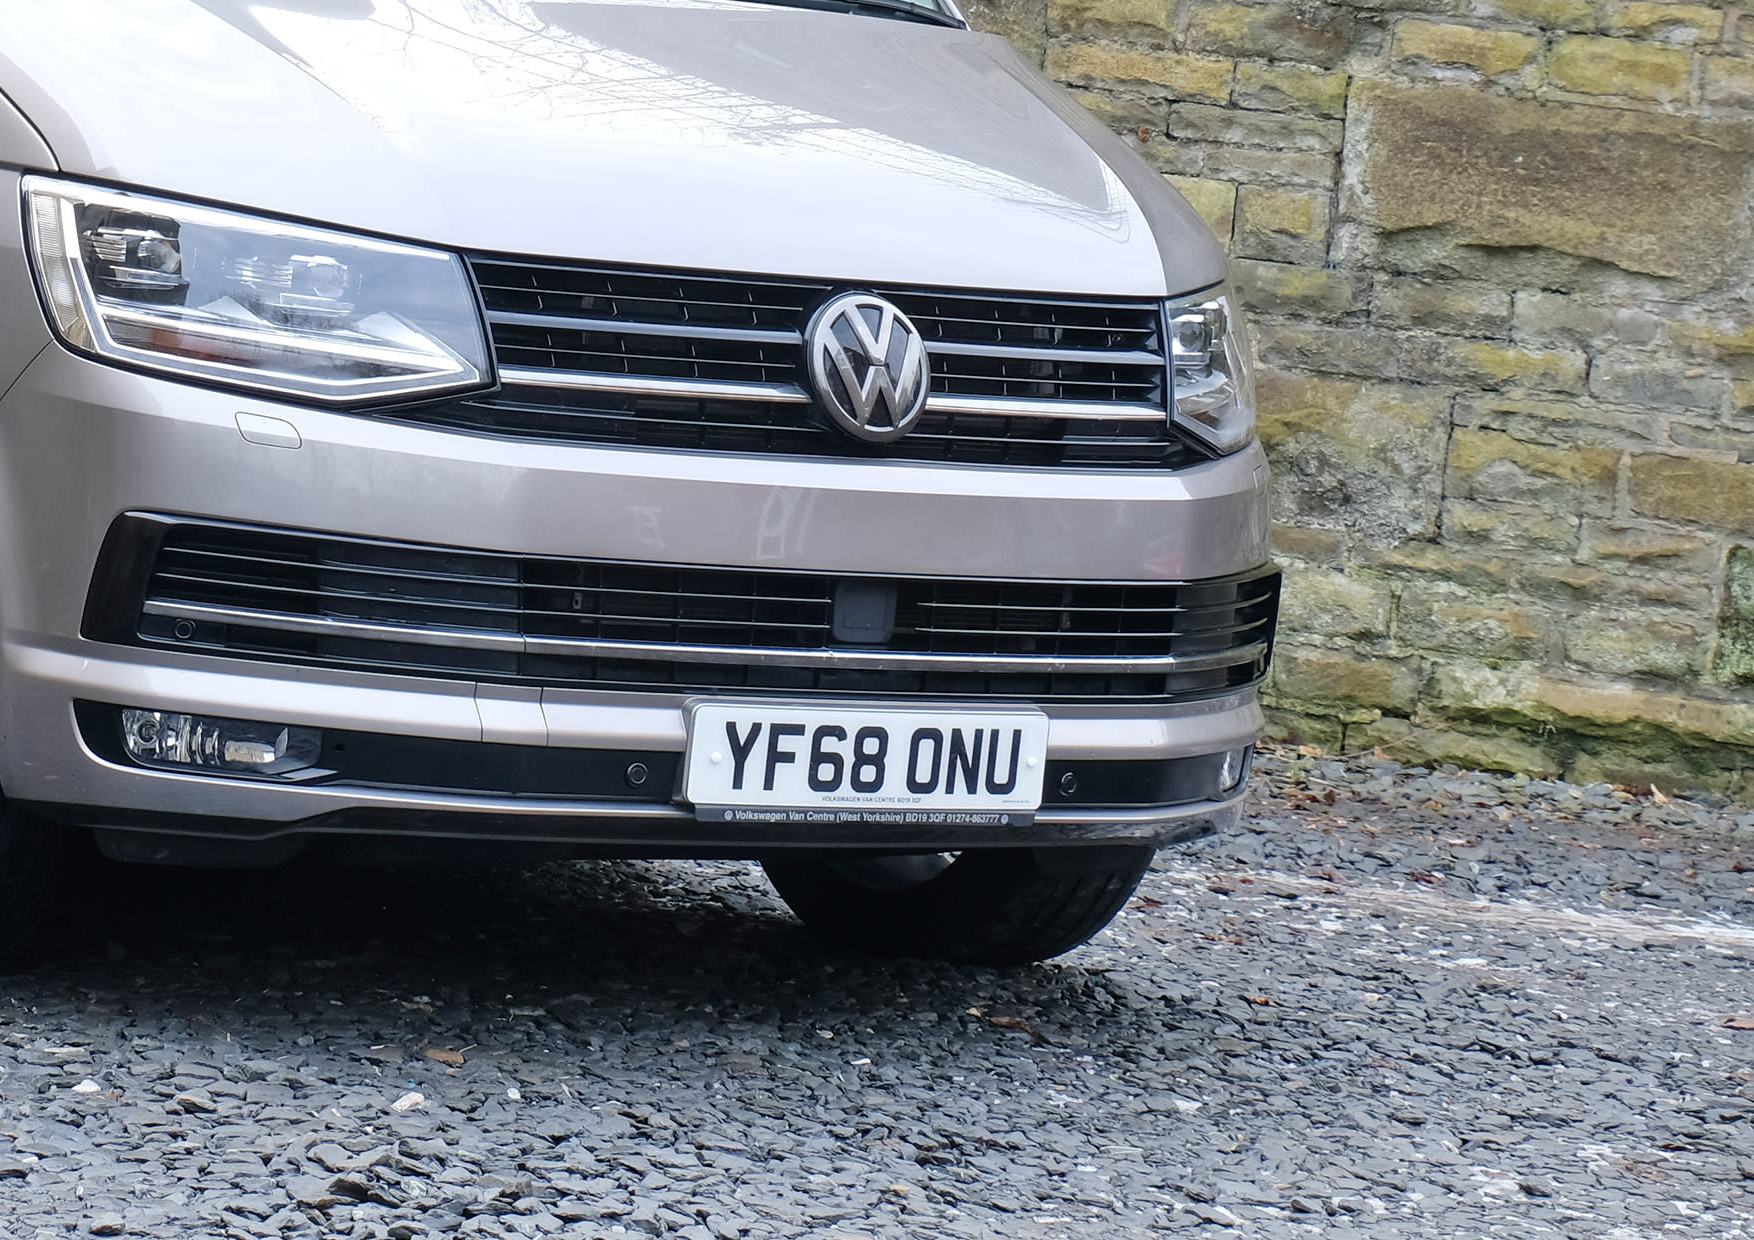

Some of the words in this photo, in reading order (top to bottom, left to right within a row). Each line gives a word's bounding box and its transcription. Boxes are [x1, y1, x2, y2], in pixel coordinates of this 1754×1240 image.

[724, 721, 890, 794] YF68
[905, 726, 1023, 795] ONU
[821, 795, 861, 803] VOLKSWAGEN
[735, 809, 787, 823] Volkswagen
[788, 810, 805, 821] Van
[806, 811, 835, 821] Centre
[836, 811, 861, 823] (West
[862, 811, 904, 824] Yorkshire)
[905, 812, 928, 823] BD19
[928, 813, 946, 823] 3QF
